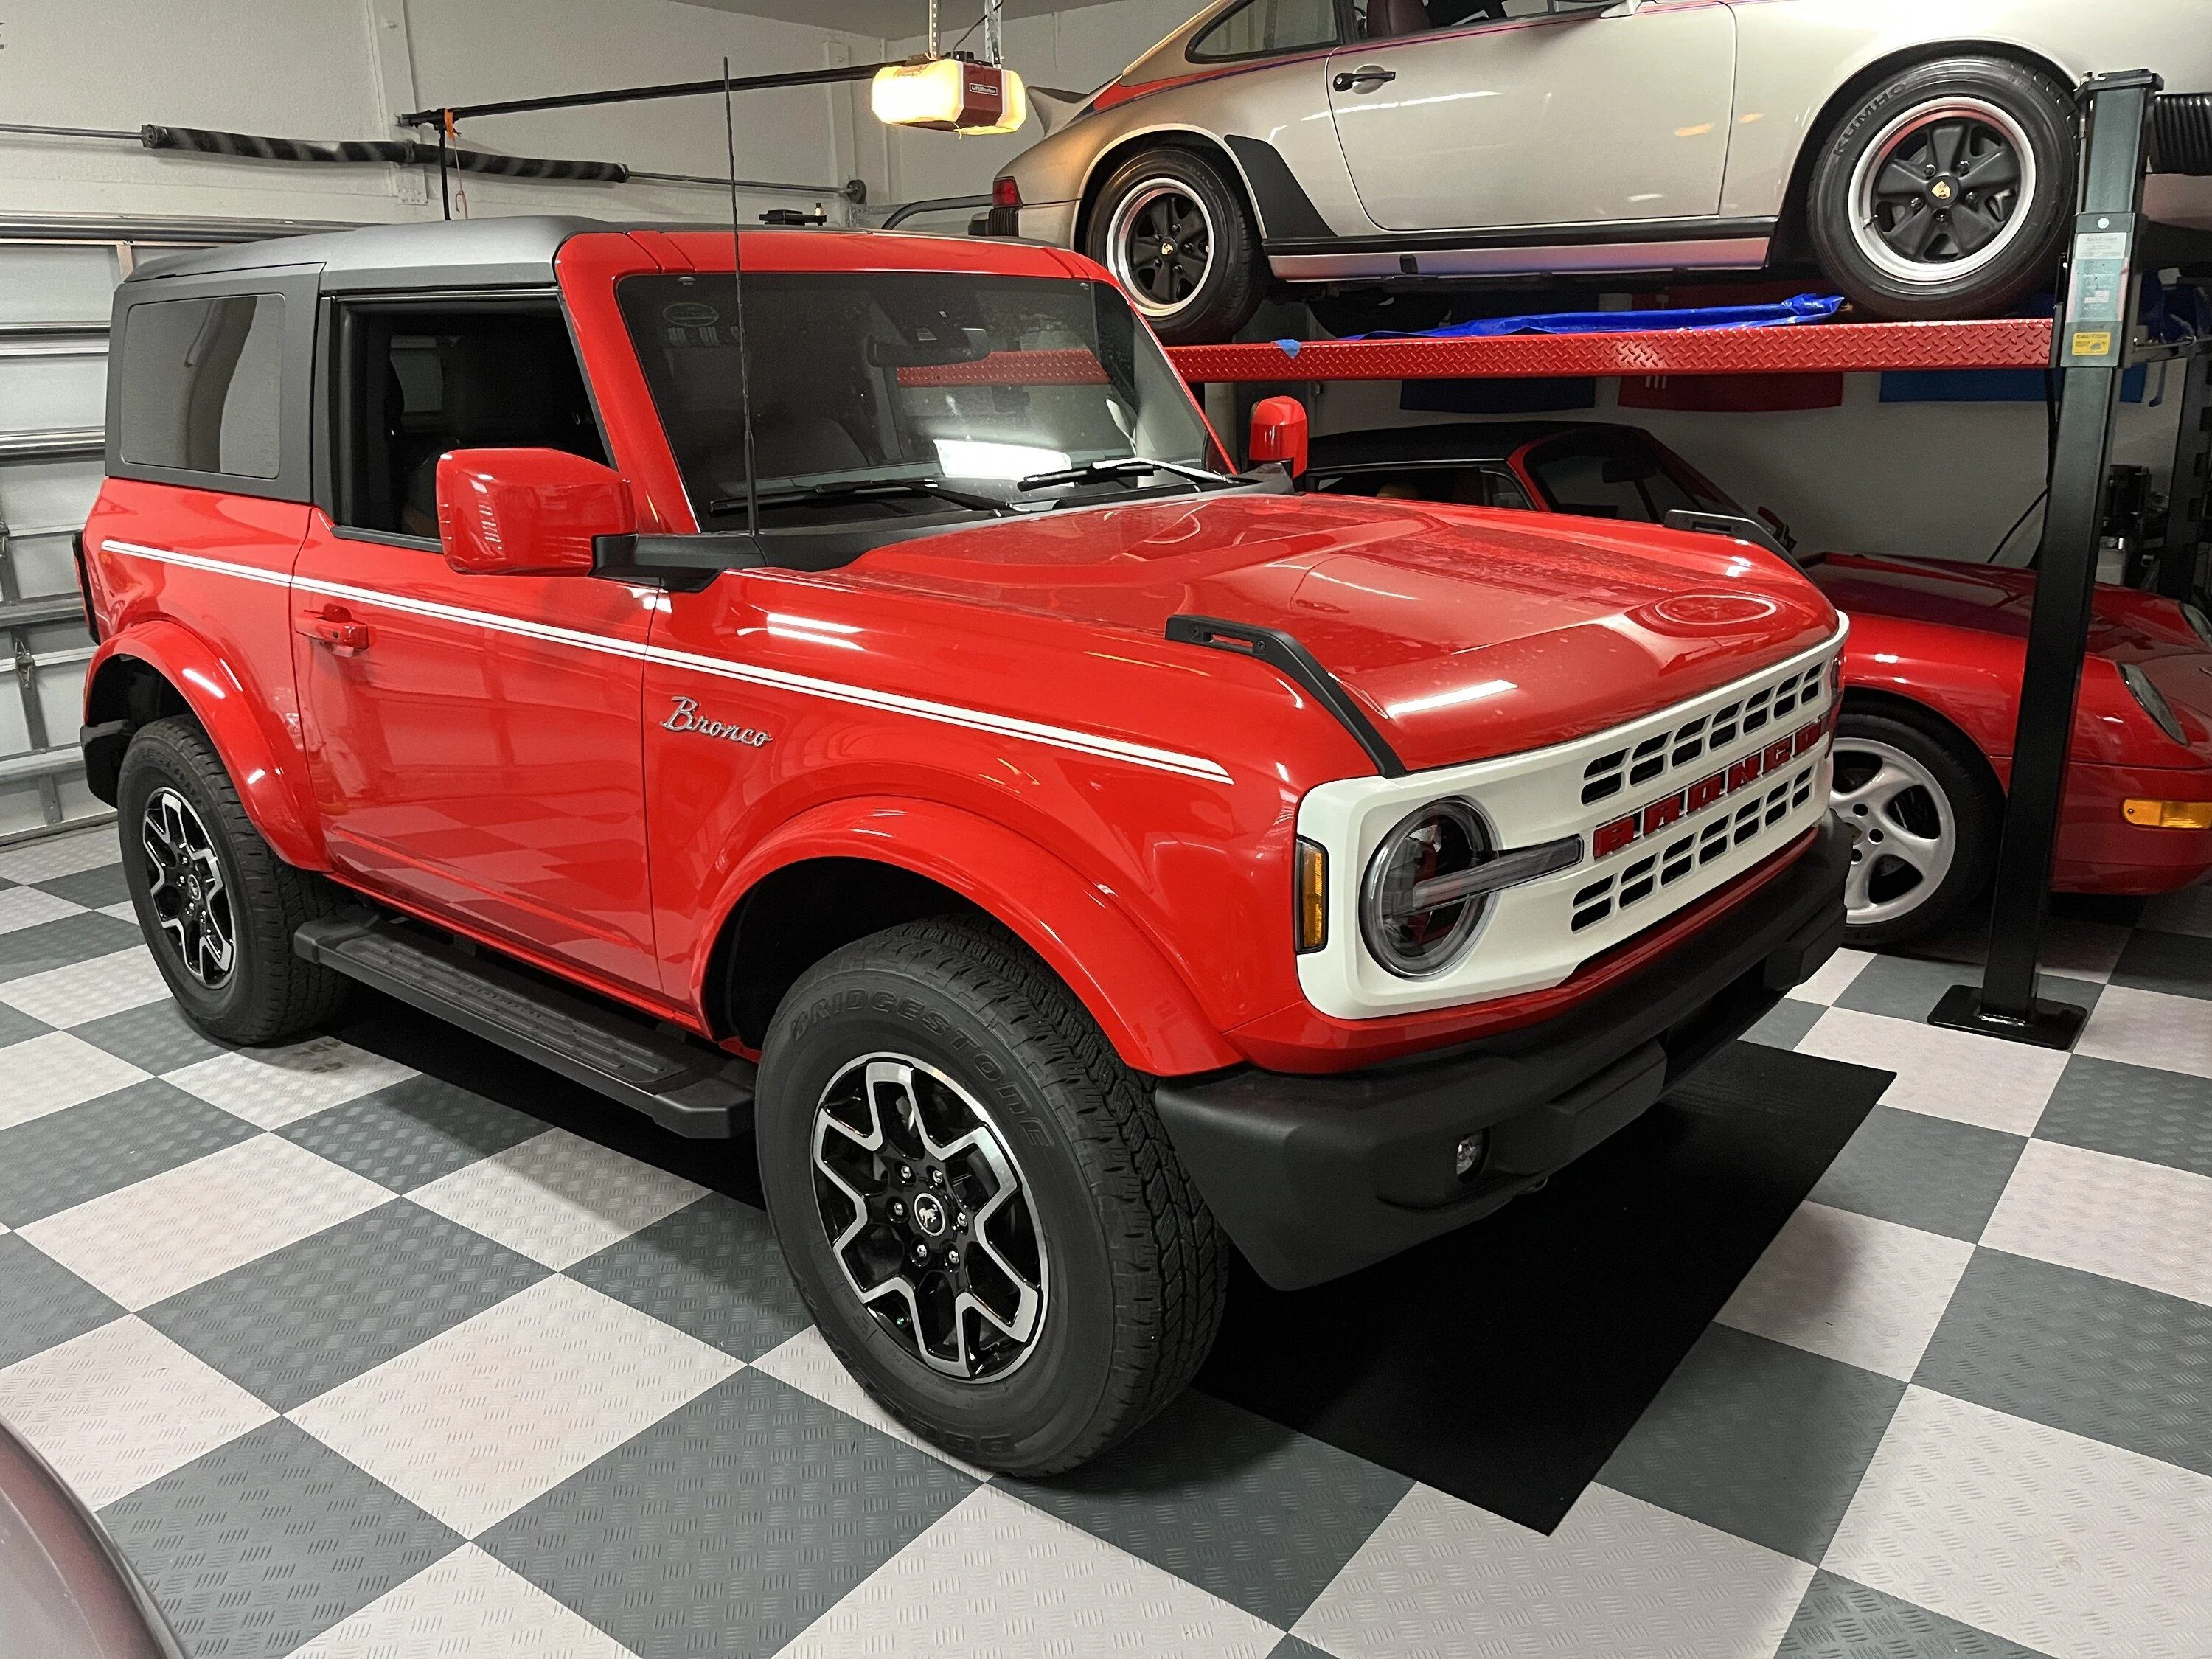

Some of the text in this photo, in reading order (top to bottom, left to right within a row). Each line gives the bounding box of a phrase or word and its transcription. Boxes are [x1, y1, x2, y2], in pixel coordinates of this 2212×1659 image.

[1834, 83, 1906, 156] KUMHO
[660, 696, 773, 747] Bronco
[1593, 721, 1821, 860] BRONCO
[790, 987, 1054, 1148] BRIDGESTONE
